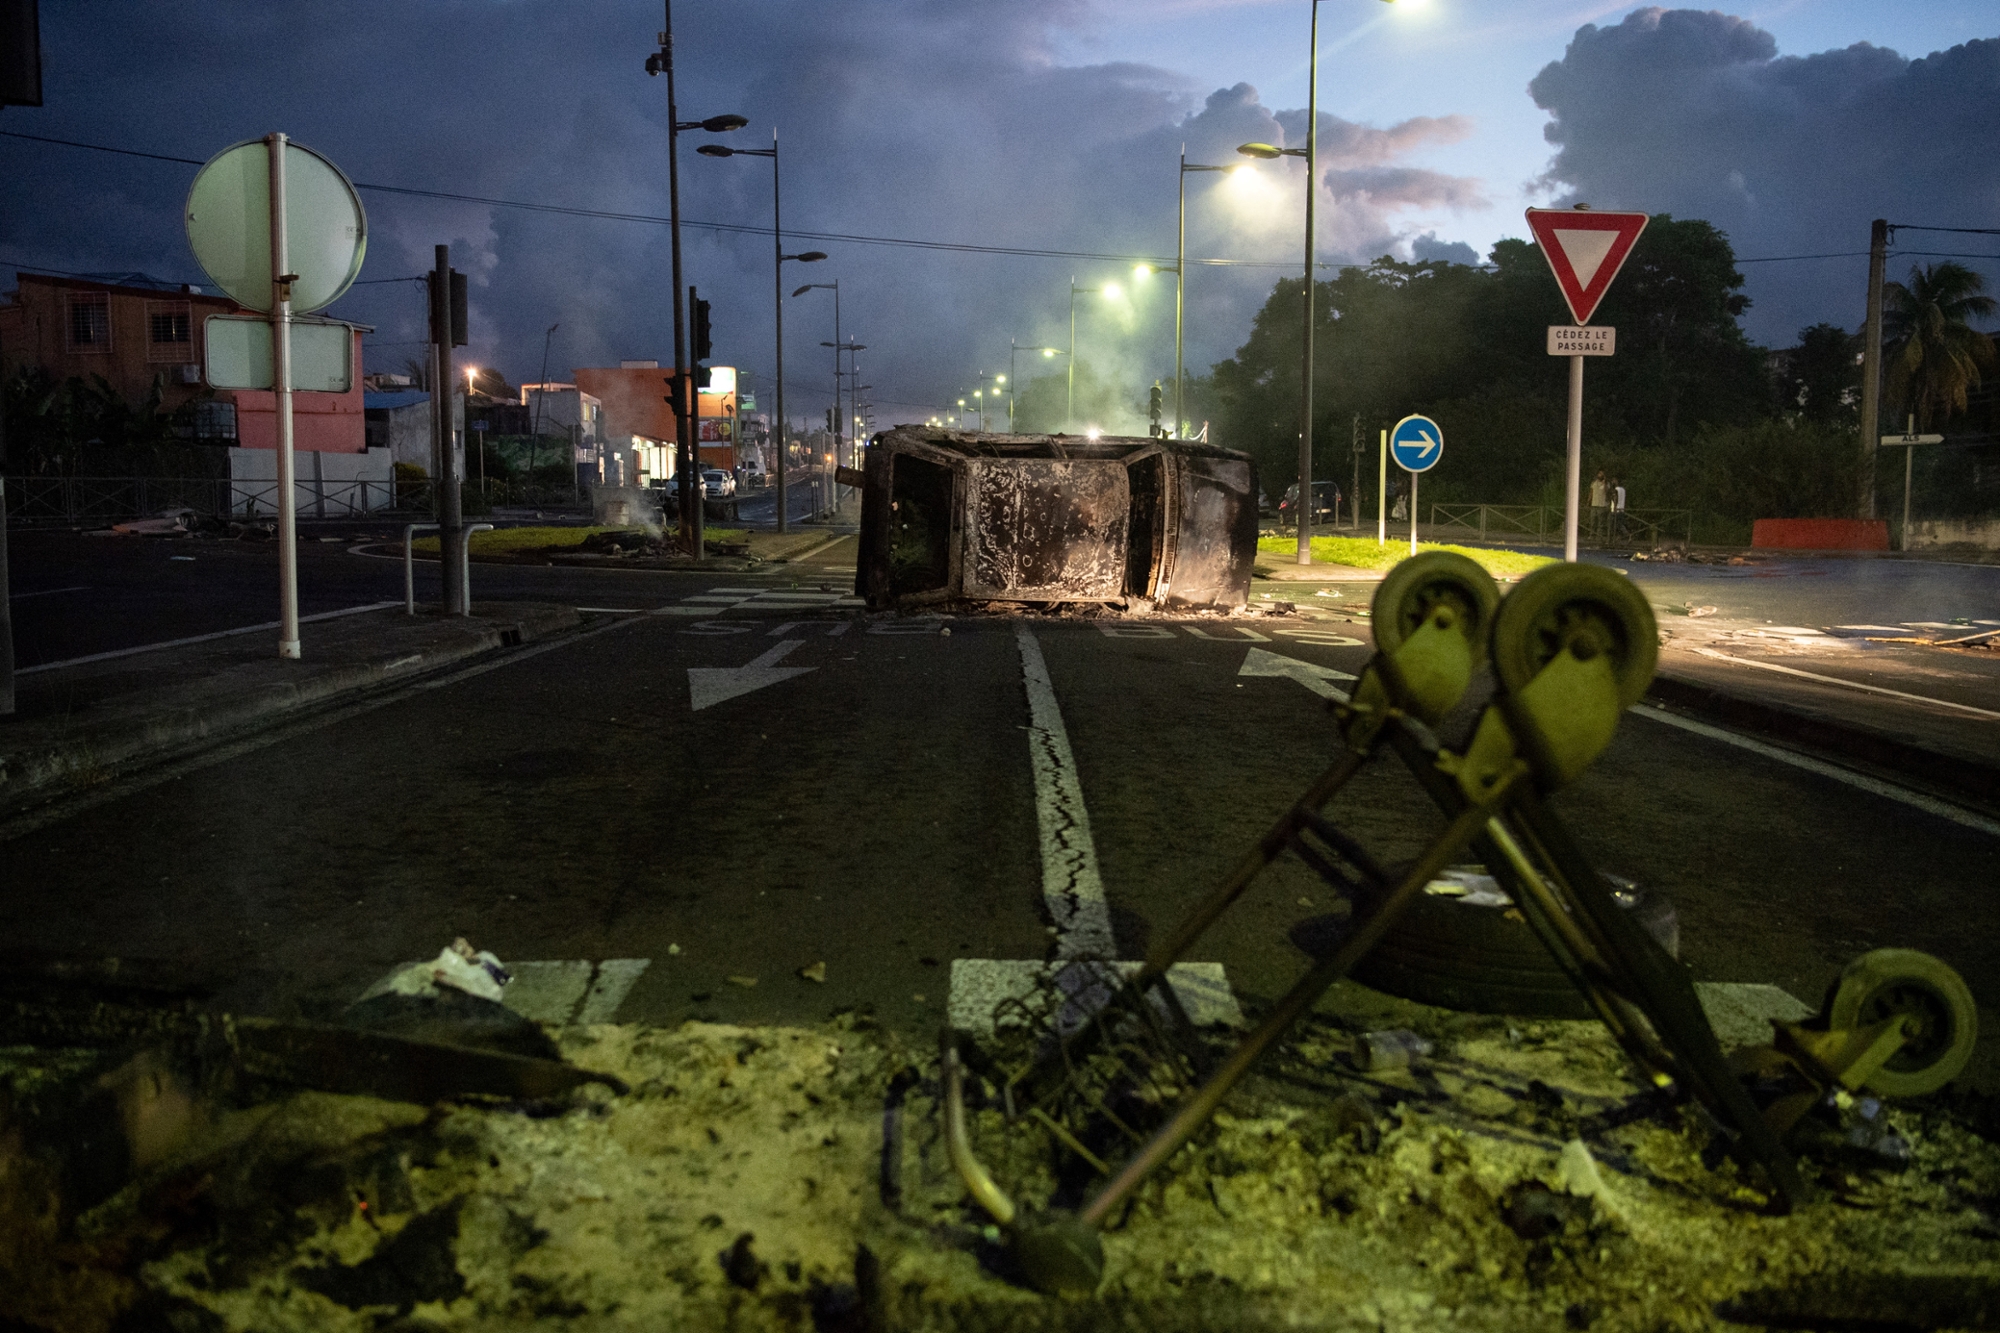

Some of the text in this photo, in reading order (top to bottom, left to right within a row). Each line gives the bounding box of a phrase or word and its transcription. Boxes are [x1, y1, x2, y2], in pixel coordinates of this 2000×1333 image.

[1556, 329, 1608, 339] CÉDEZ LE
[1557, 342, 1605, 351] PASSAGE
[1093, 622, 1366, 646] BUS
